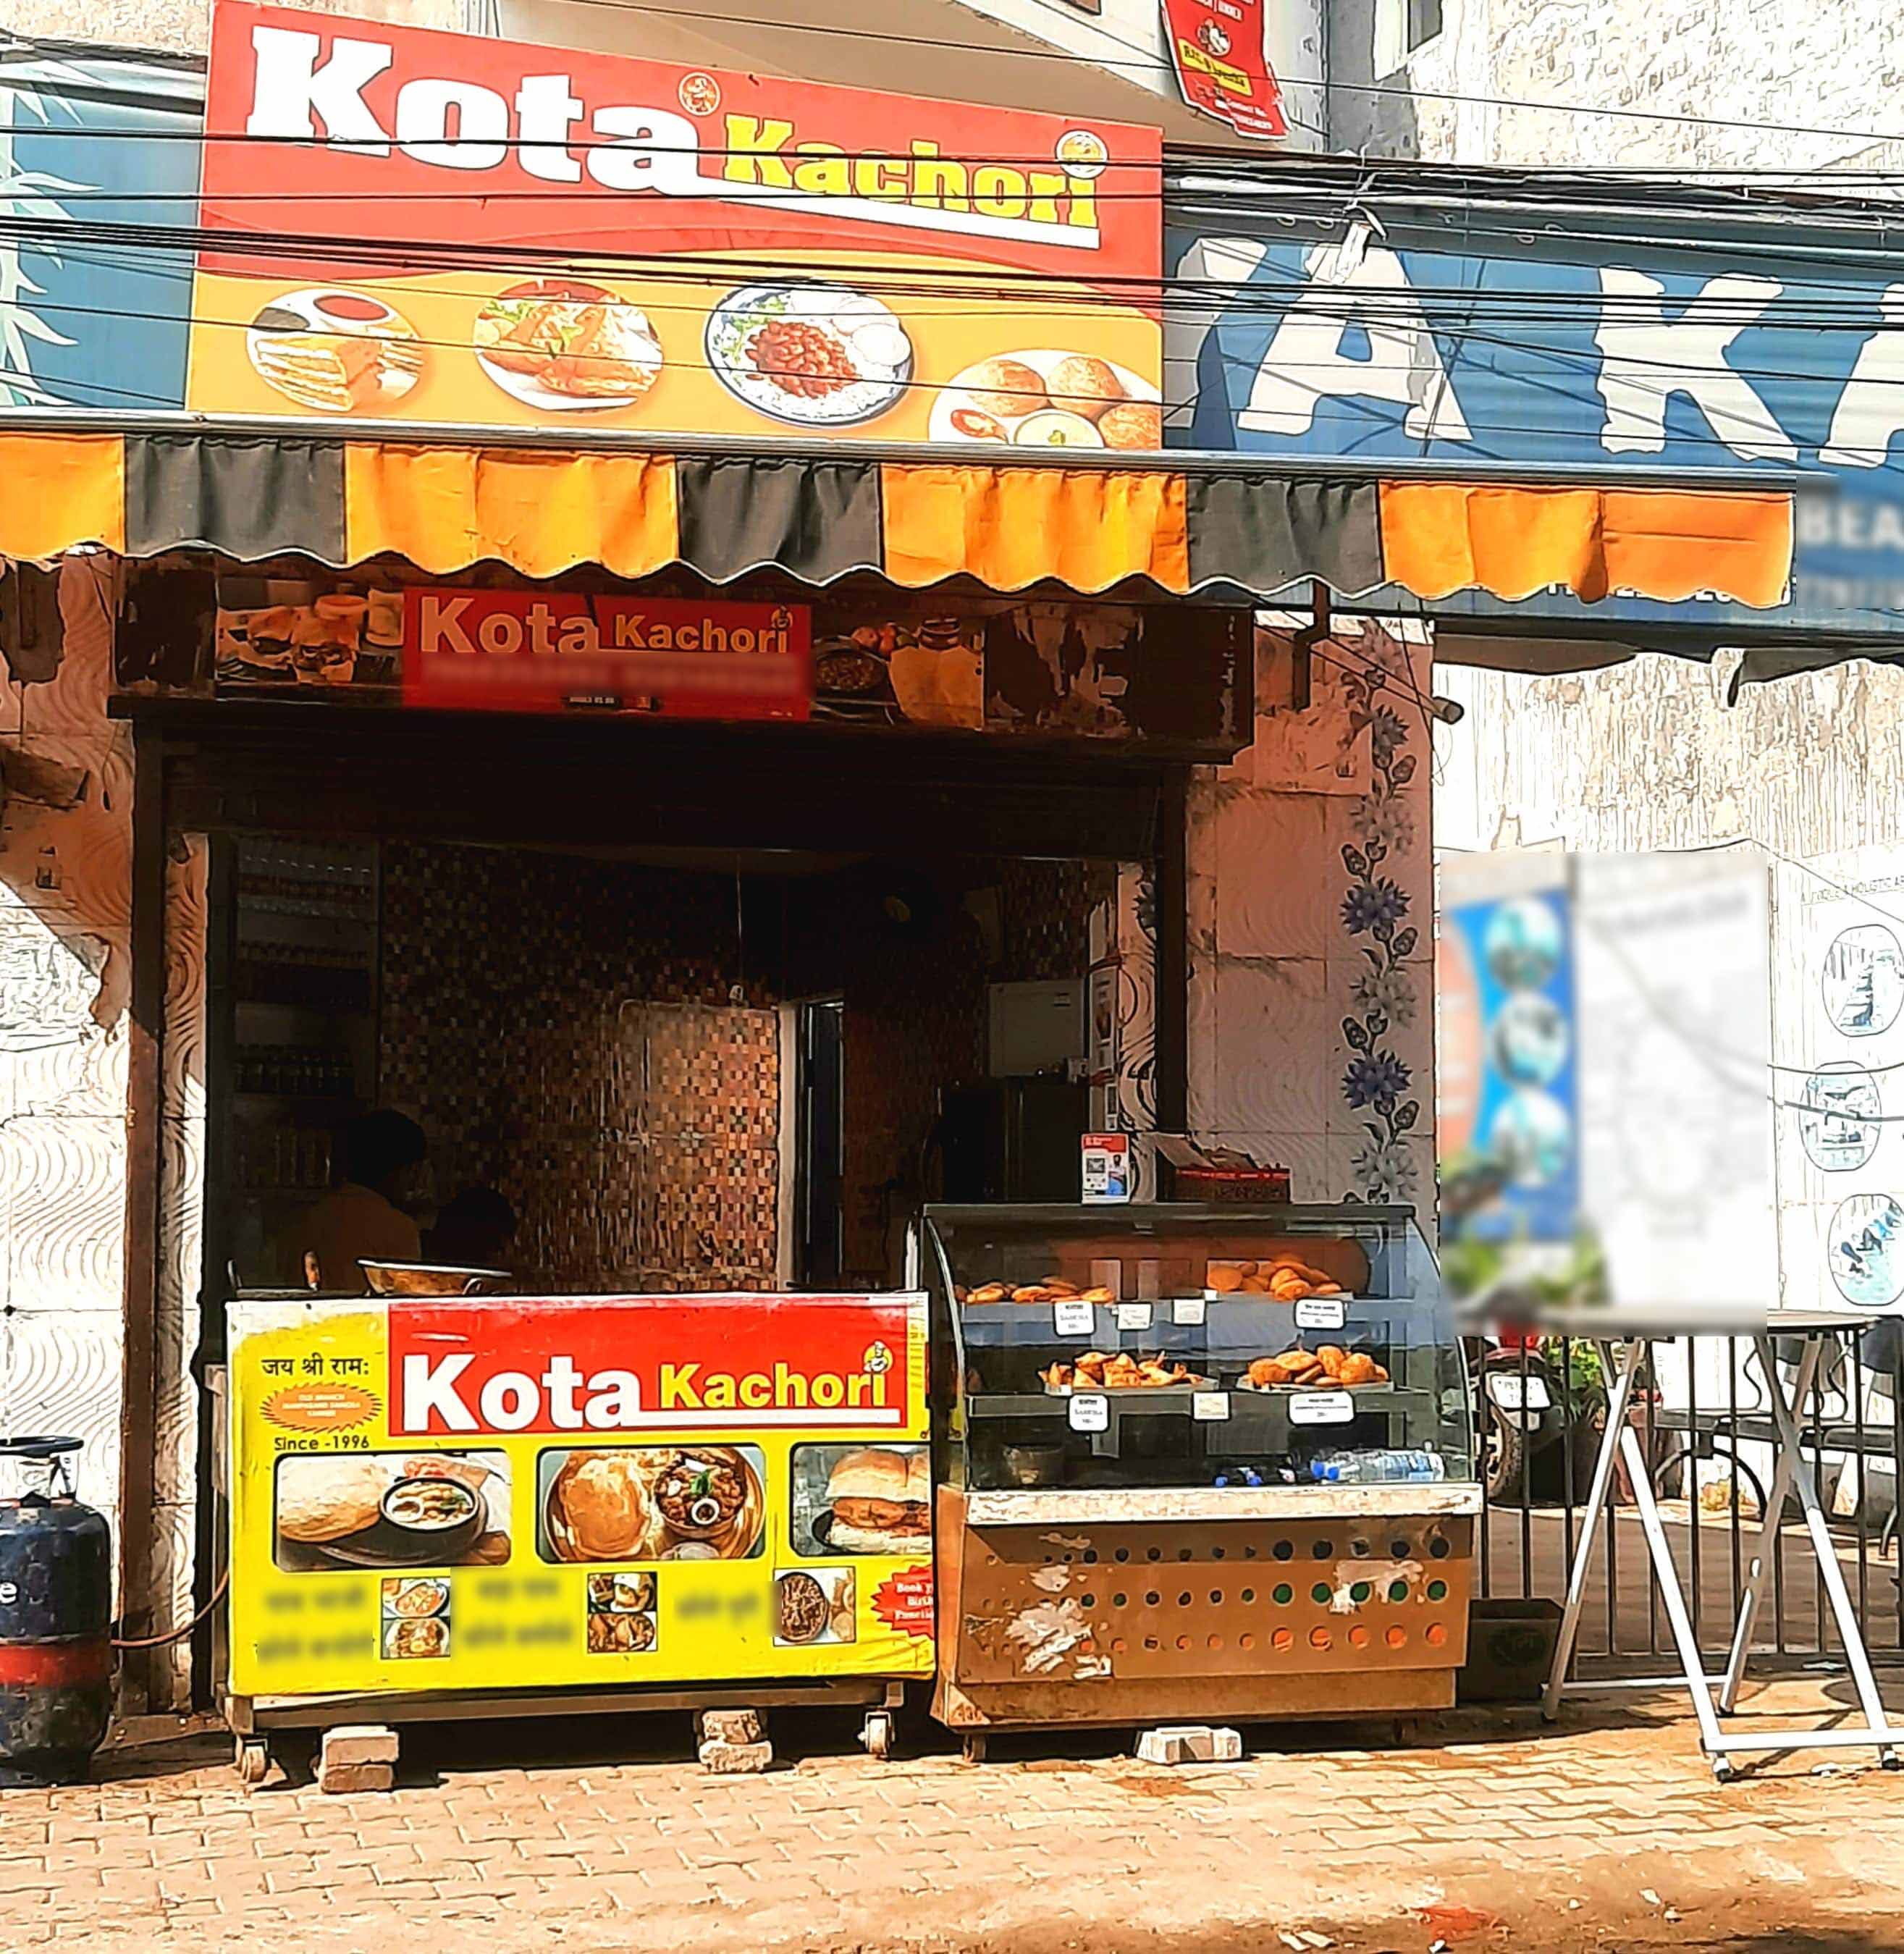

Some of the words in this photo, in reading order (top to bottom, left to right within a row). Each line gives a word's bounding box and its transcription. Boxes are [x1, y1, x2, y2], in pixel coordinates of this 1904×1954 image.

[246, 25, 700, 197] Kota
[724, 114, 1099, 227] Kachori
[421, 595, 599, 654] Kota
[615, 613, 788, 654] Kachori
[261, 1359, 295, 1376] जय
[302, 1352, 324, 1376] श्री
[403, 1353, 642, 1433] Kota
[658, 1363, 887, 1410] Kachori
[274, 1437, 319, 1451] Since
